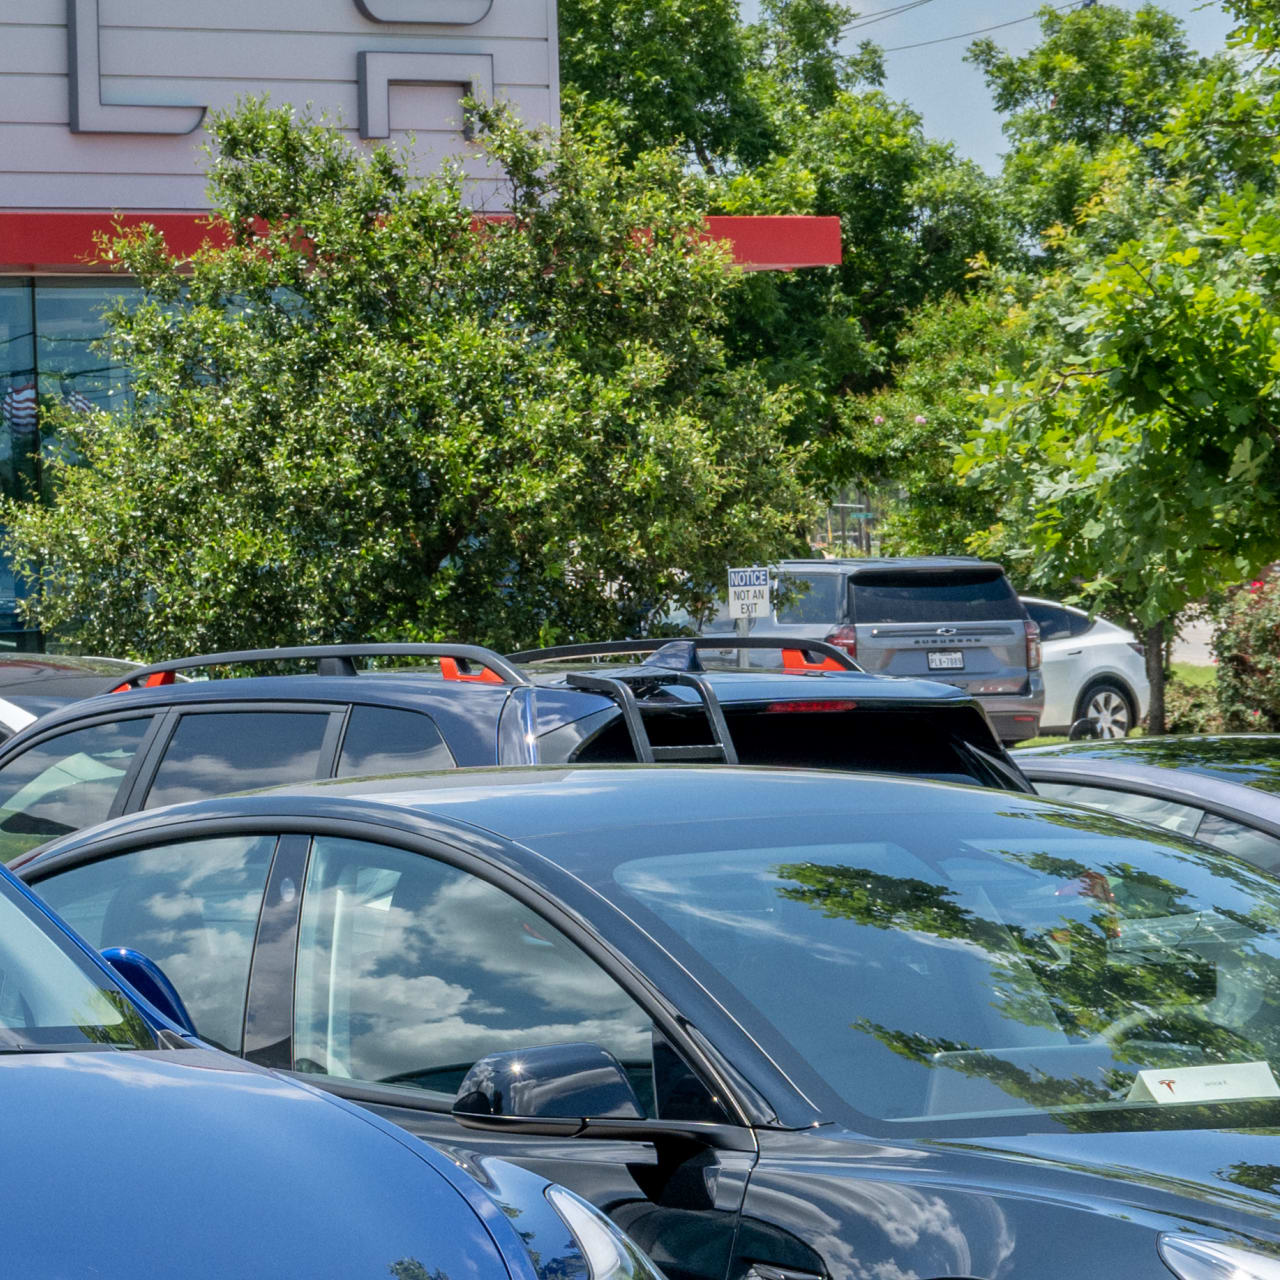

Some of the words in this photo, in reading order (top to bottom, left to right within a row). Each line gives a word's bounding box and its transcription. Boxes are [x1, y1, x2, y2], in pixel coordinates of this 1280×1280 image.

[730, 571, 767, 586] NOTICE
[734, 590, 750, 600] NOT
[752, 589, 765, 600] AN
[741, 603, 758, 614] EXIT
